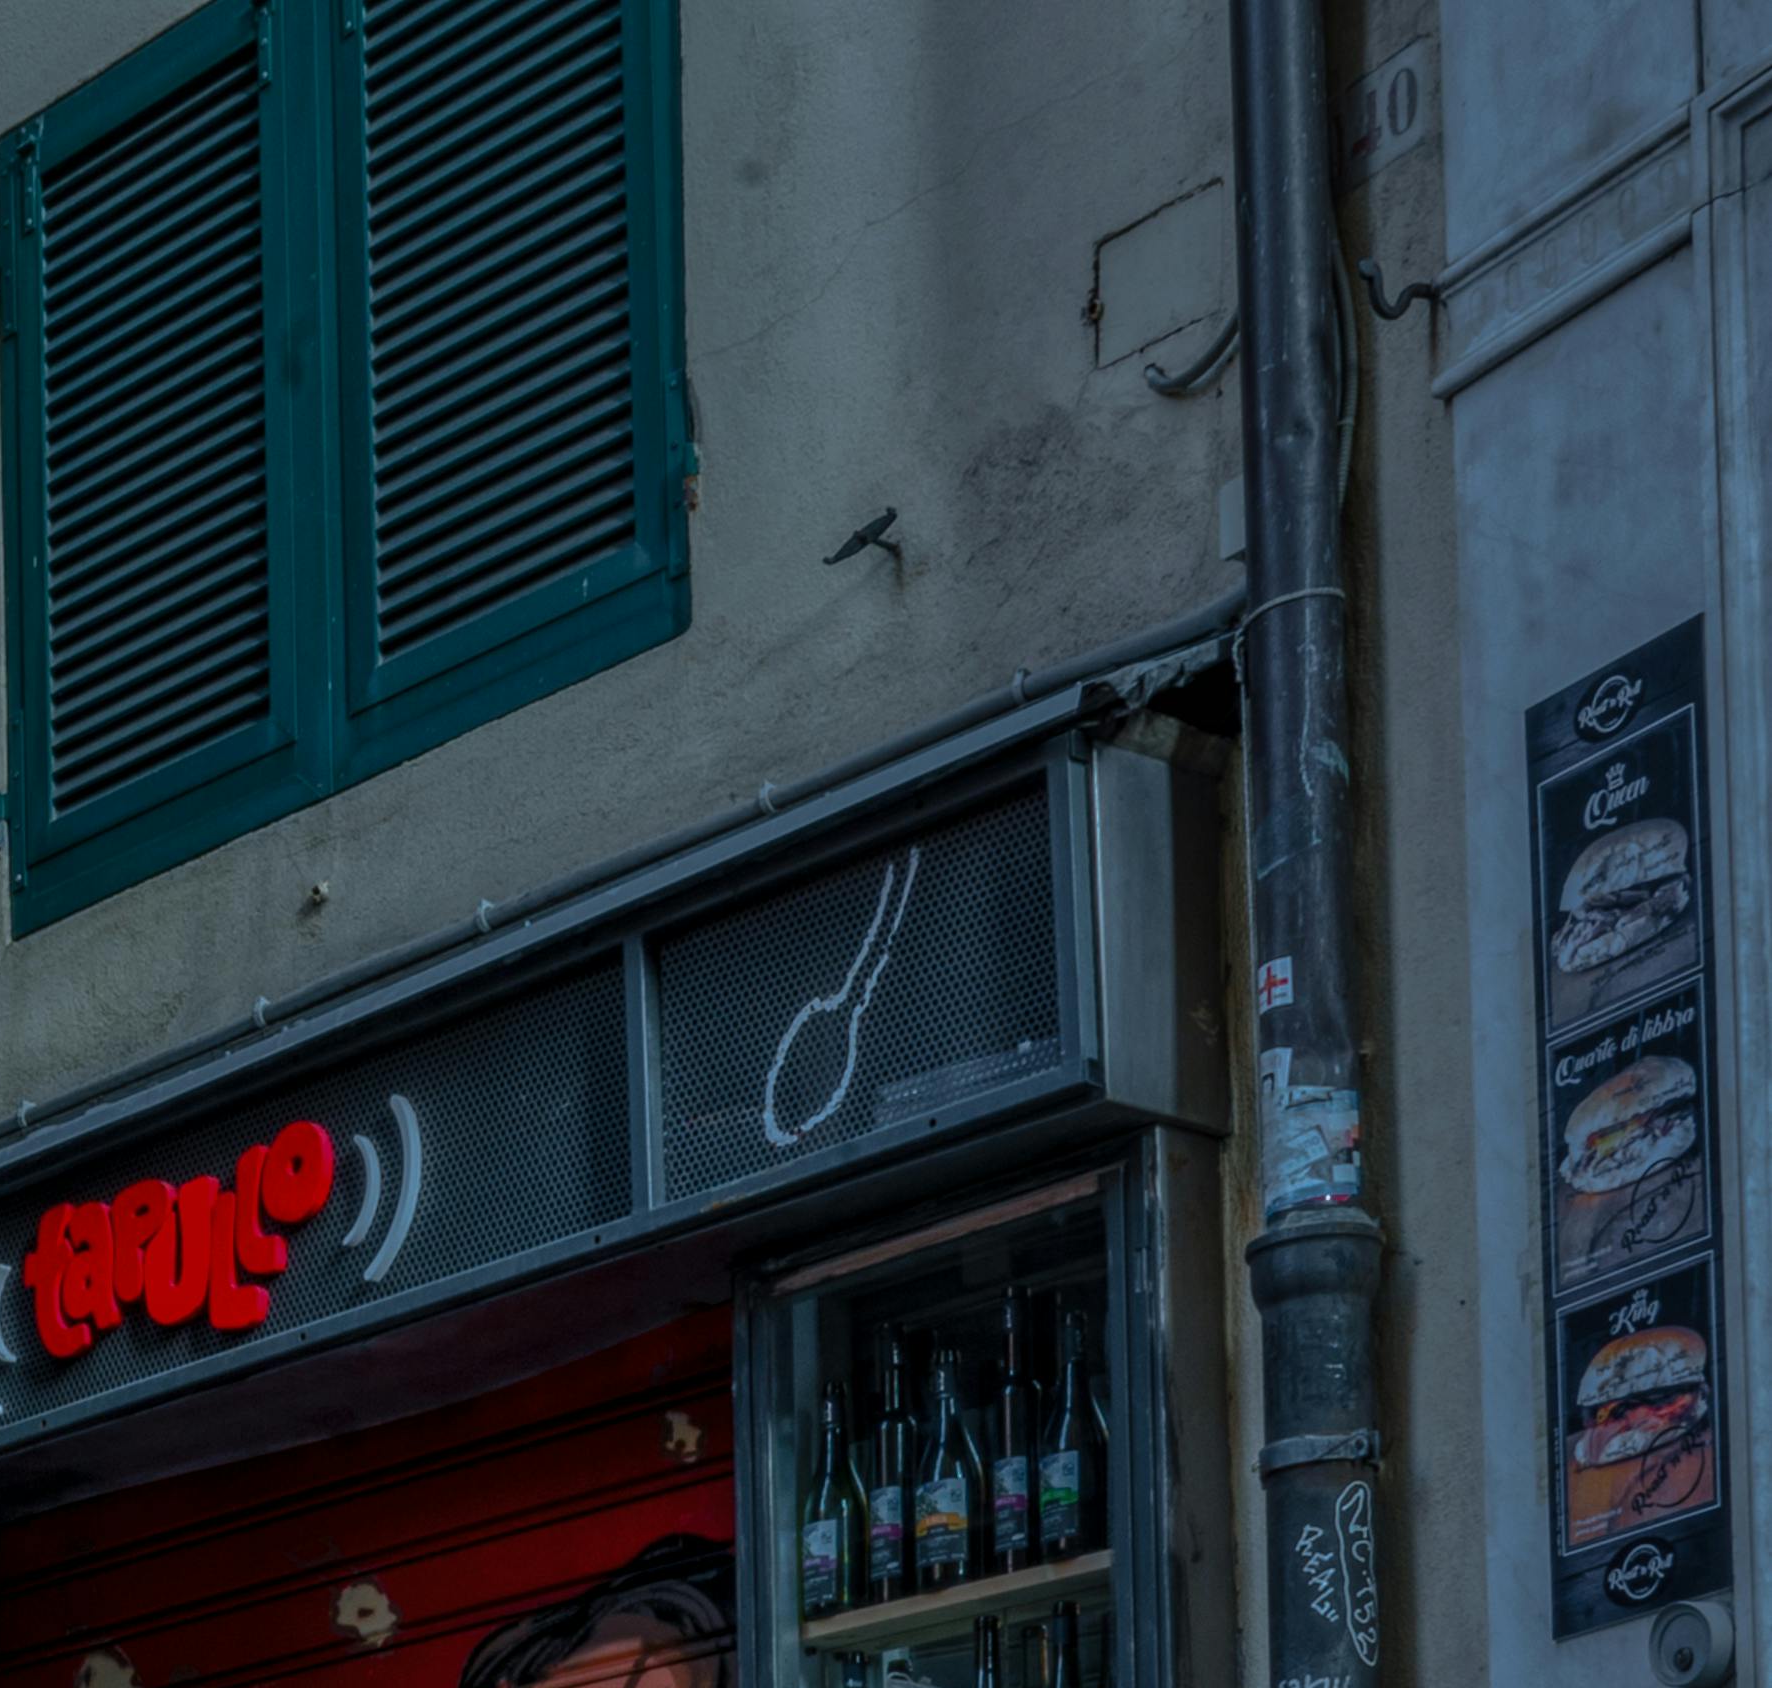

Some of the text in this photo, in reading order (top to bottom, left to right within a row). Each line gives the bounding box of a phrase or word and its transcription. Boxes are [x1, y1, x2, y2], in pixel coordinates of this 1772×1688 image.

[1583, 776, 1650, 830] Queen
[1555, 1006, 1696, 1087] Quarto di libbra
[1609, 1298, 1661, 1336] King
